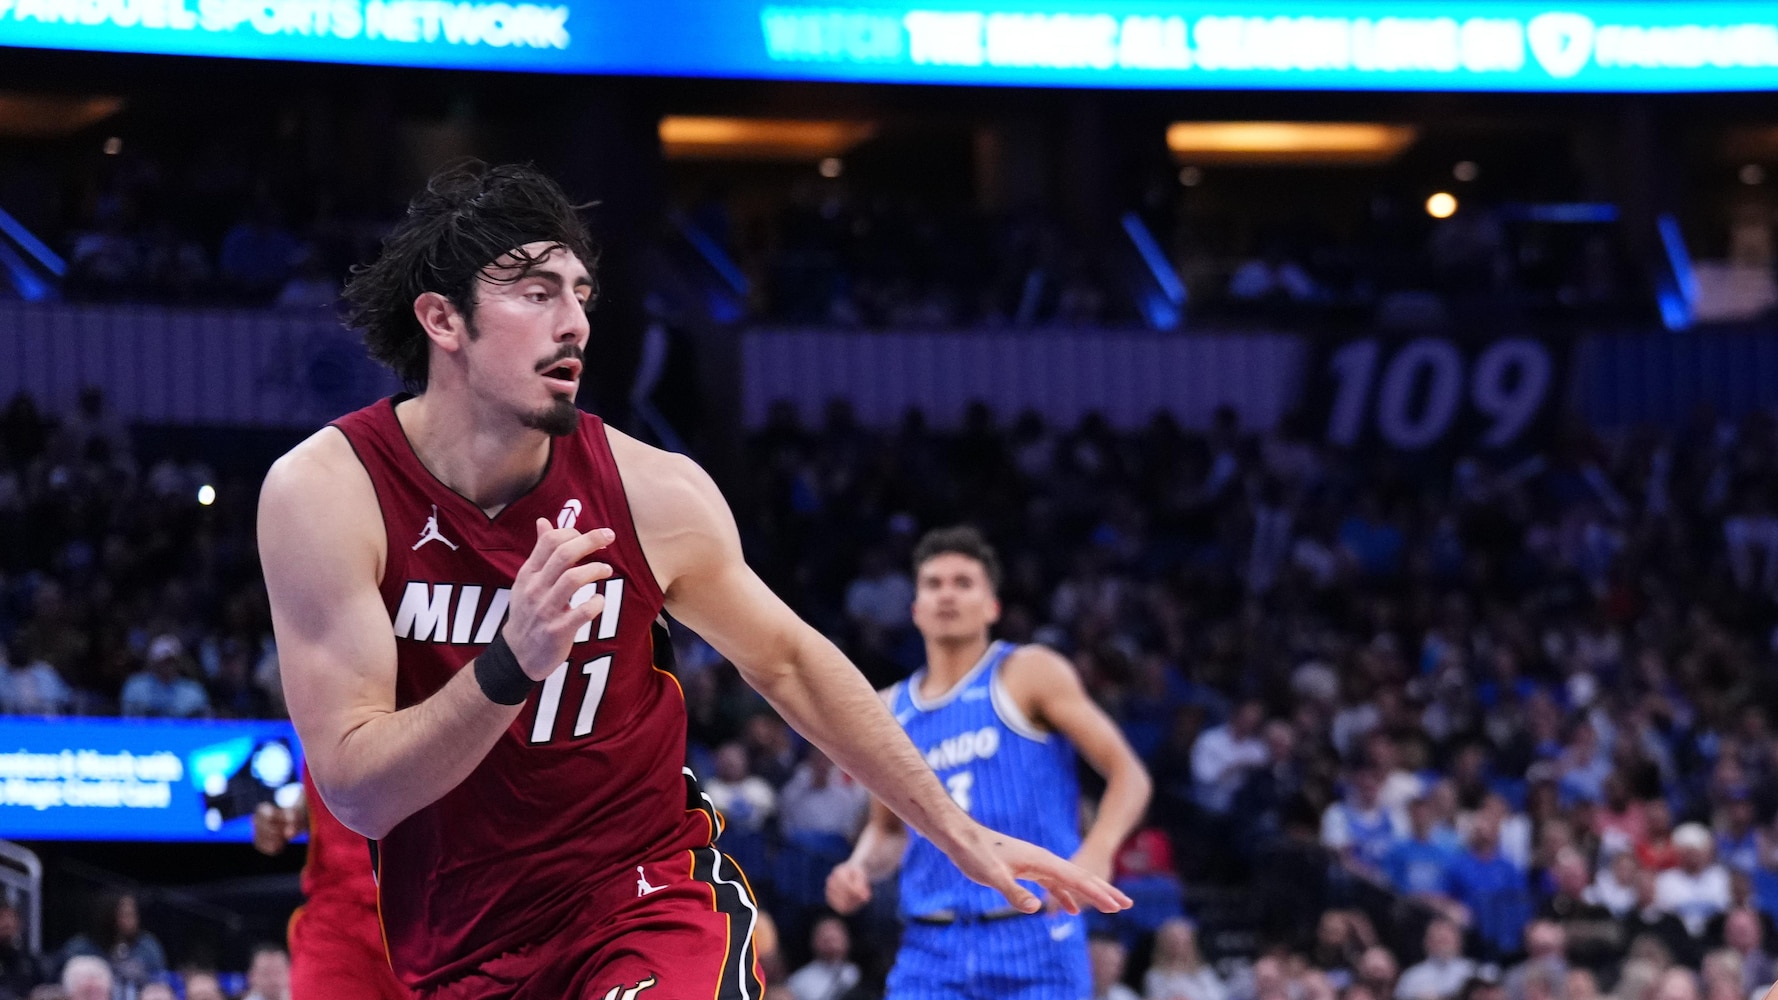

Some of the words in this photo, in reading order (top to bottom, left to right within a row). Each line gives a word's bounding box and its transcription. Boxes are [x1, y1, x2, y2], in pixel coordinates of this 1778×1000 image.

[903, 10, 985, 65] THE
[1119, 15, 1190, 70] ALL
[1327, 336, 1552, 449] 109
[529, 652, 614, 745] 11
